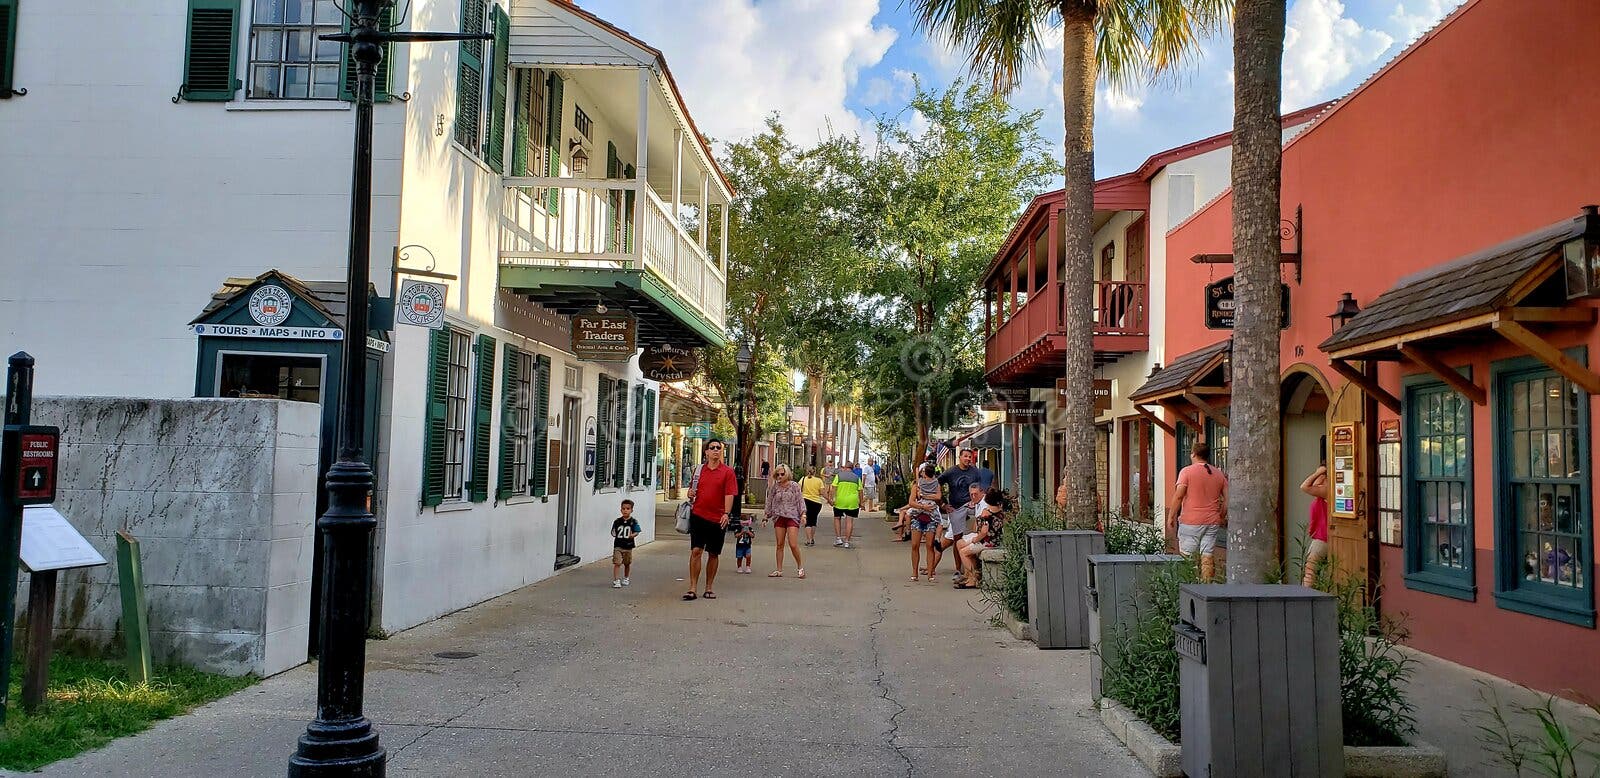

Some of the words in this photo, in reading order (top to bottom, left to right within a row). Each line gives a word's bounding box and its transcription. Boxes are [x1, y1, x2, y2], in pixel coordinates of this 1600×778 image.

[256, 312, 286, 324] TOURS
[407, 308, 436, 323] TOURS
[580, 318, 599, 329] Far
[601, 319, 628, 330] East
[212, 326, 248, 336] TOURS
[259, 328, 290, 337] MAPS
[301, 329, 326, 338] INFO
[582, 330, 625, 341] Traders
[650, 346, 690, 357] Sunburst
[650, 369, 684, 380] Crystal
[23, 450, 54, 458] RESTROOMS
[617, 525, 632, 539] 20
